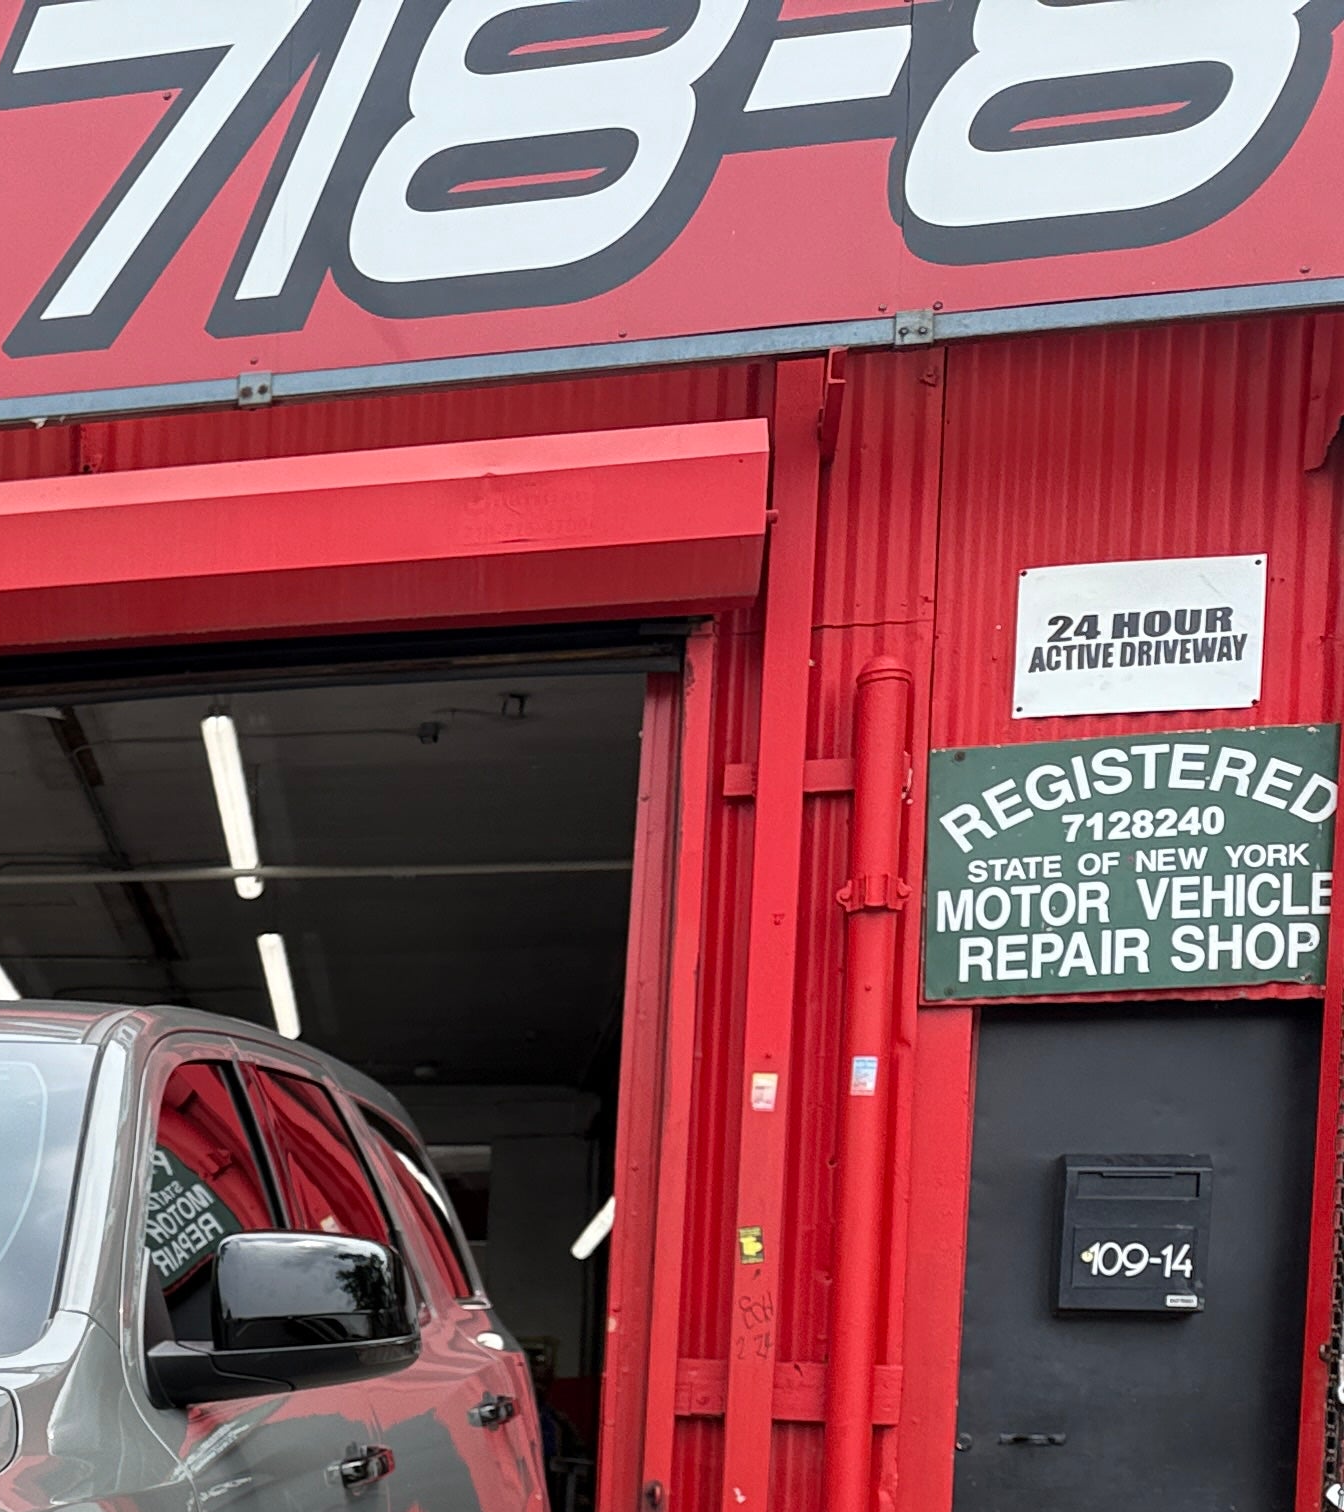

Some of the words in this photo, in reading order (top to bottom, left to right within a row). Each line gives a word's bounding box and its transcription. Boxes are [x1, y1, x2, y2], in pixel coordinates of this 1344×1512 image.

[1046, 614, 1102, 643] 24
[1110, 605, 1234, 641] HOUR
[1027, 641, 1115, 674] ACTIVE
[1119, 633, 1248, 667] DRIVEWAY
[938, 743, 1339, 854] REGISTERED
[1061, 805, 1226, 844] 7128240
[967, 854, 1063, 884] STATE
[1077, 851, 1121, 877] OF
[1134, 846, 1209, 873] NEW
[1224, 842, 1310, 869] YORK
[936, 880, 1111, 933] MOTOR
[1136, 871, 1333, 921] VEHICLE
[958, 927, 1150, 984] REPAIR
[1169, 921, 1321, 972] SHOP
[1089, 1241, 1193, 1279] 109-14
